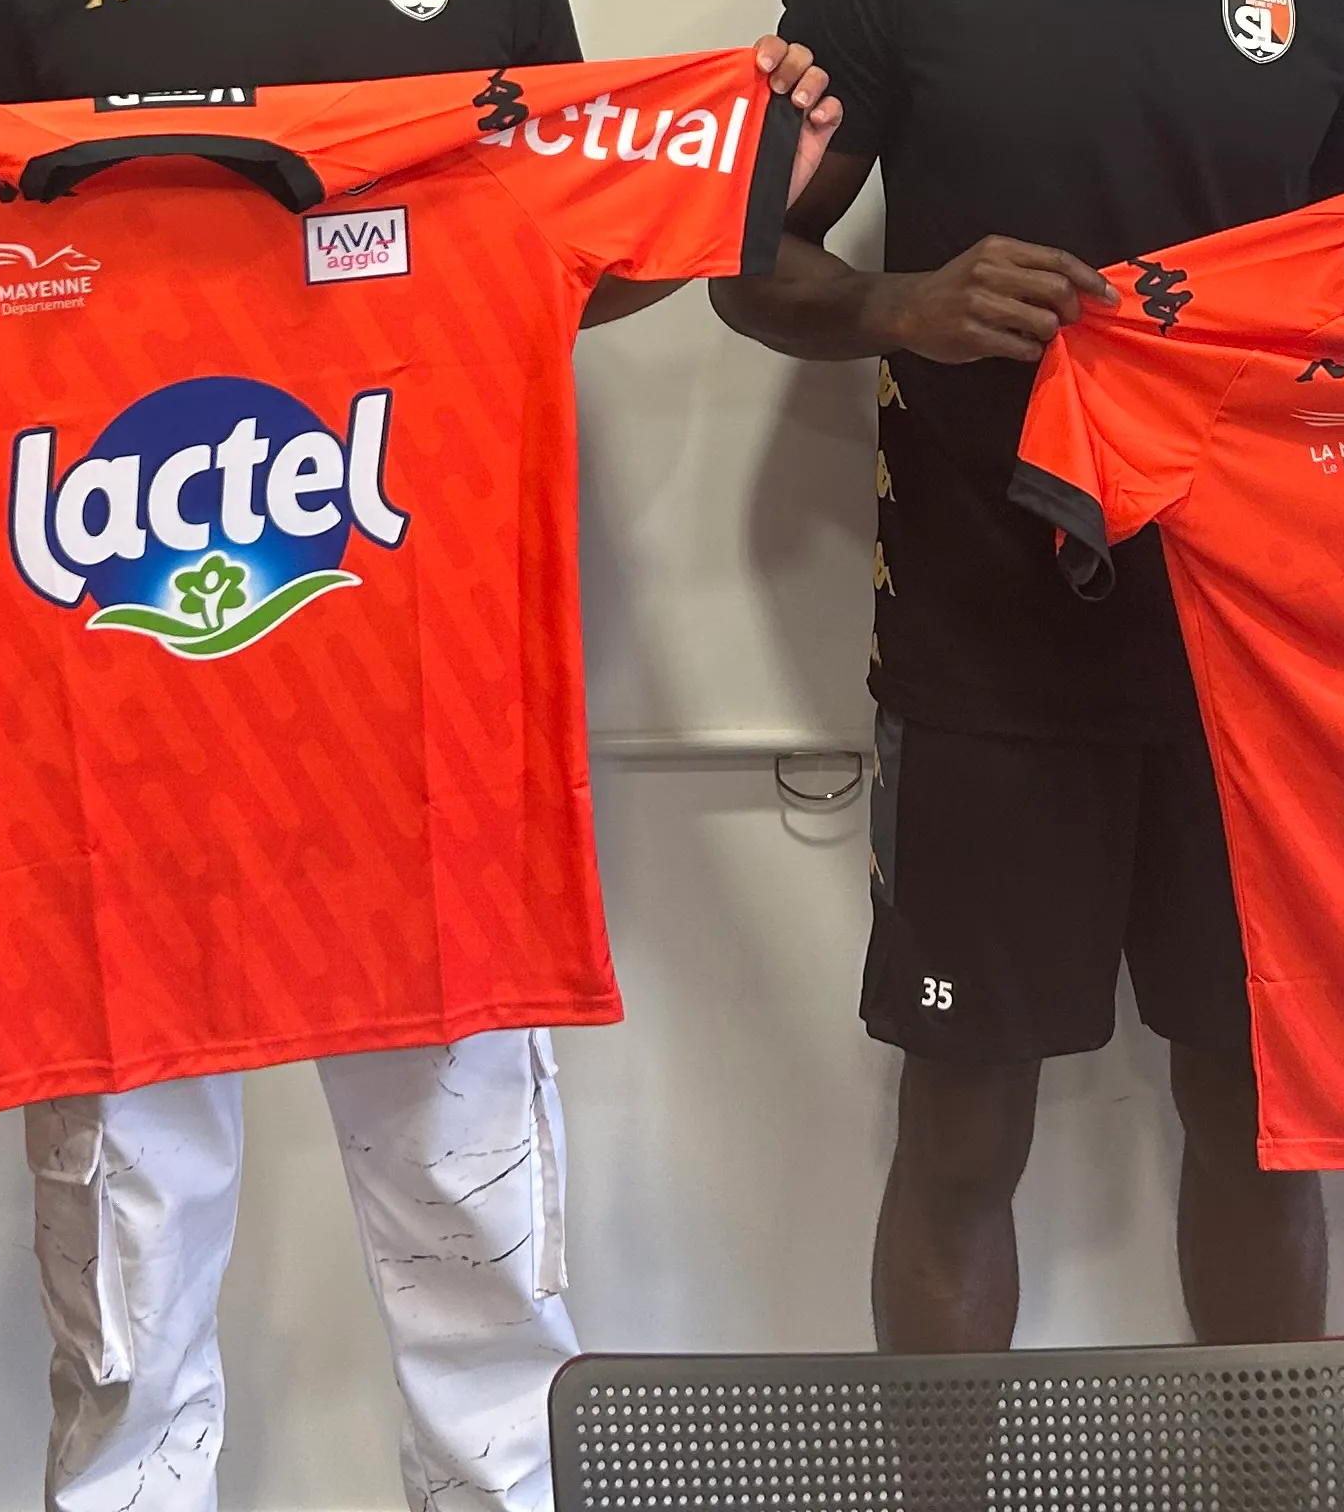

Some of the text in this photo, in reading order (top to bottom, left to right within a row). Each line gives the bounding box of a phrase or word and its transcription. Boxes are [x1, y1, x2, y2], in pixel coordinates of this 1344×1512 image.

[327, 251, 389, 271] agglo
[1, 296, 85, 316] Département
[1310, 444, 1335, 462] LA
[1322, 462, 1338, 475] Le
[11, 391, 408, 606] lactel
[921, 977, 953, 1010] 35
